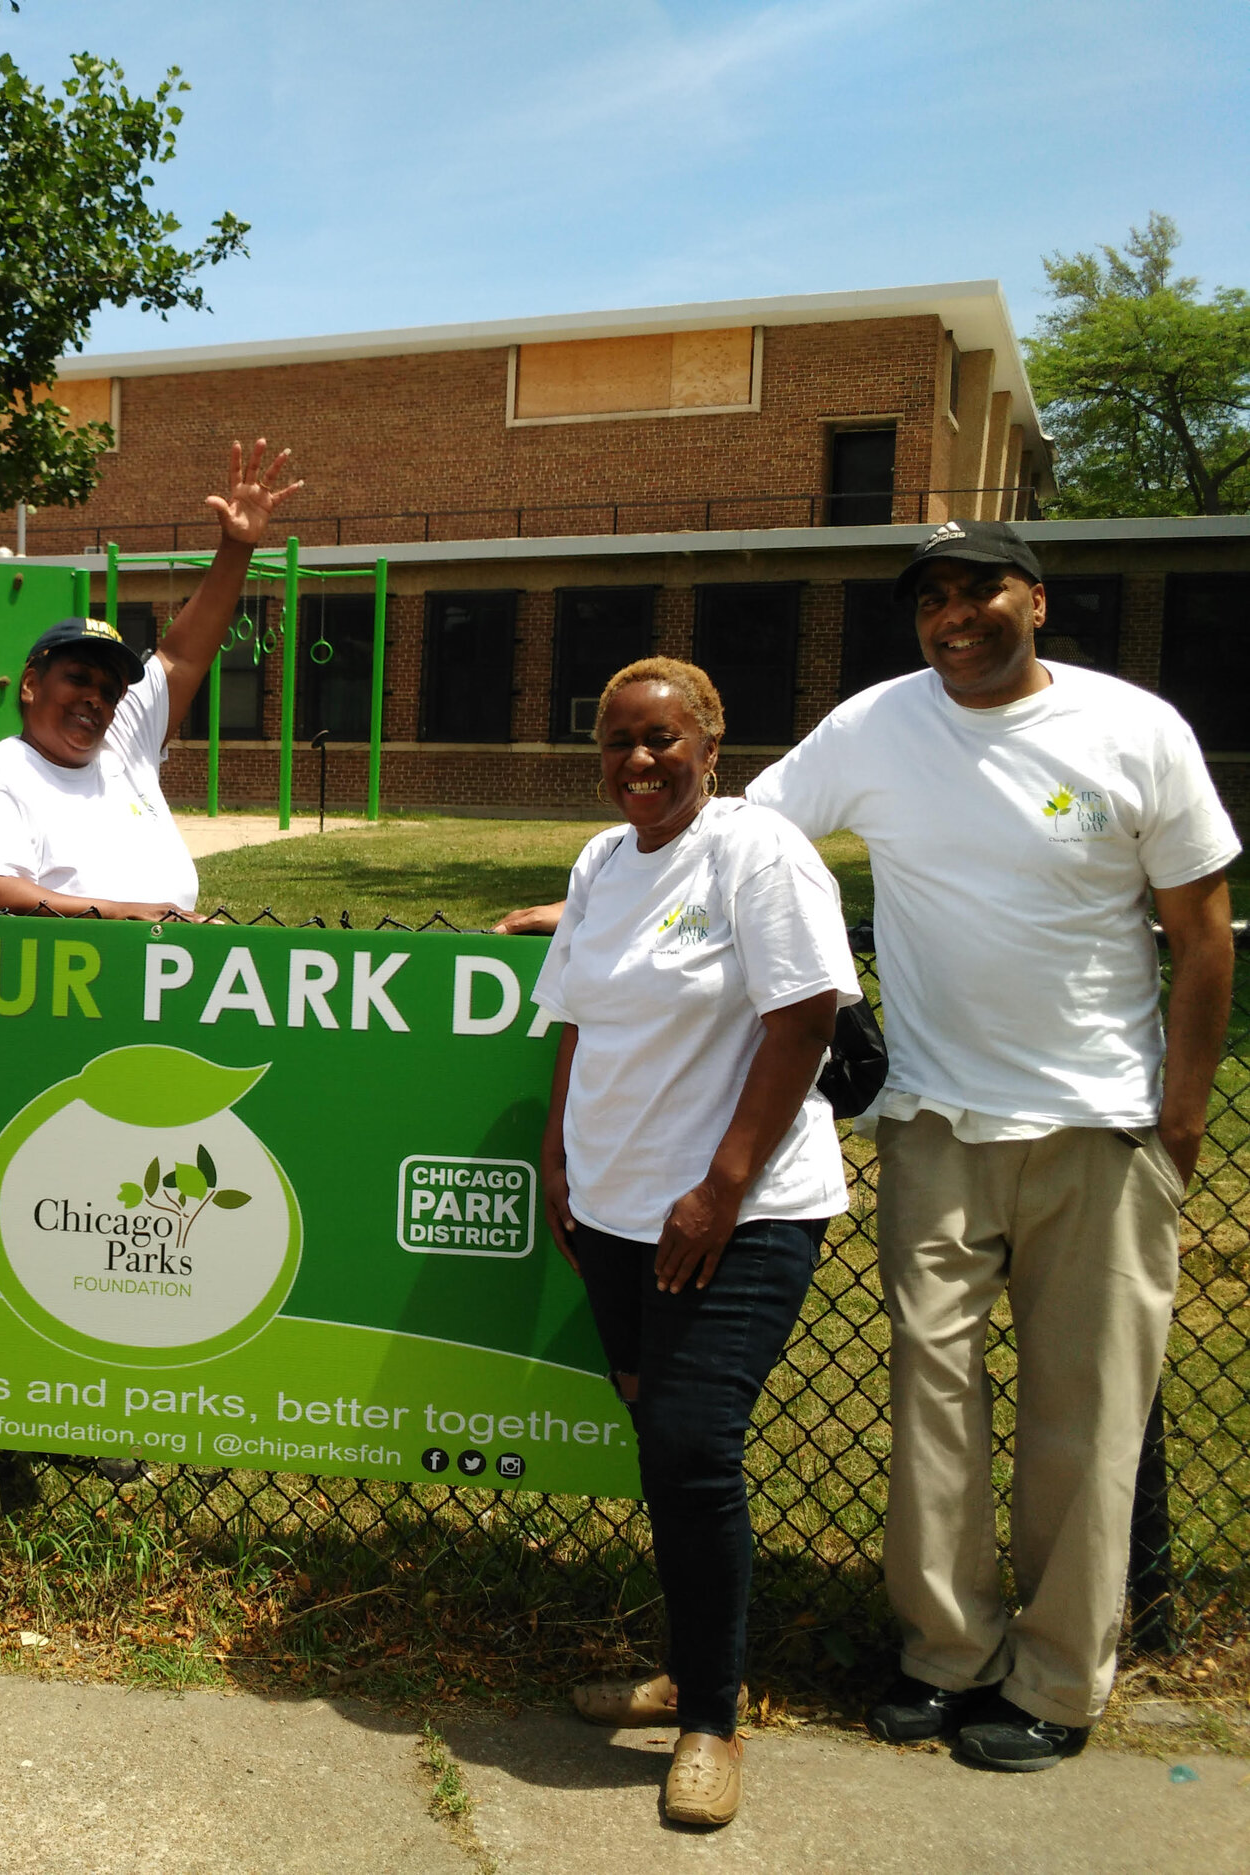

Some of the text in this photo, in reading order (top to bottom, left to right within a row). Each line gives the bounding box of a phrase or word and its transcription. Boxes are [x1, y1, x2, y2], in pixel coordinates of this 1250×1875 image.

[924, 532, 966, 552] adidas
[143, 943, 411, 1032] PARK
[412, 1166, 523, 1190] CHICAGO
[34, 1198, 173, 1248] Chicago
[411, 1189, 521, 1224] PARK
[409, 1223, 521, 1247] DISTRICT
[104, 1239, 193, 1276] Parks
[73, 1276, 192, 1297] FOUNDATION
[26, 1379, 107, 1408] and
[124, 1385, 258, 1424] parks,
[277, 1391, 410, 1430] better
[423, 1405, 627, 1447] together.
[213, 1433, 401, 1466] @chiparksfdn
